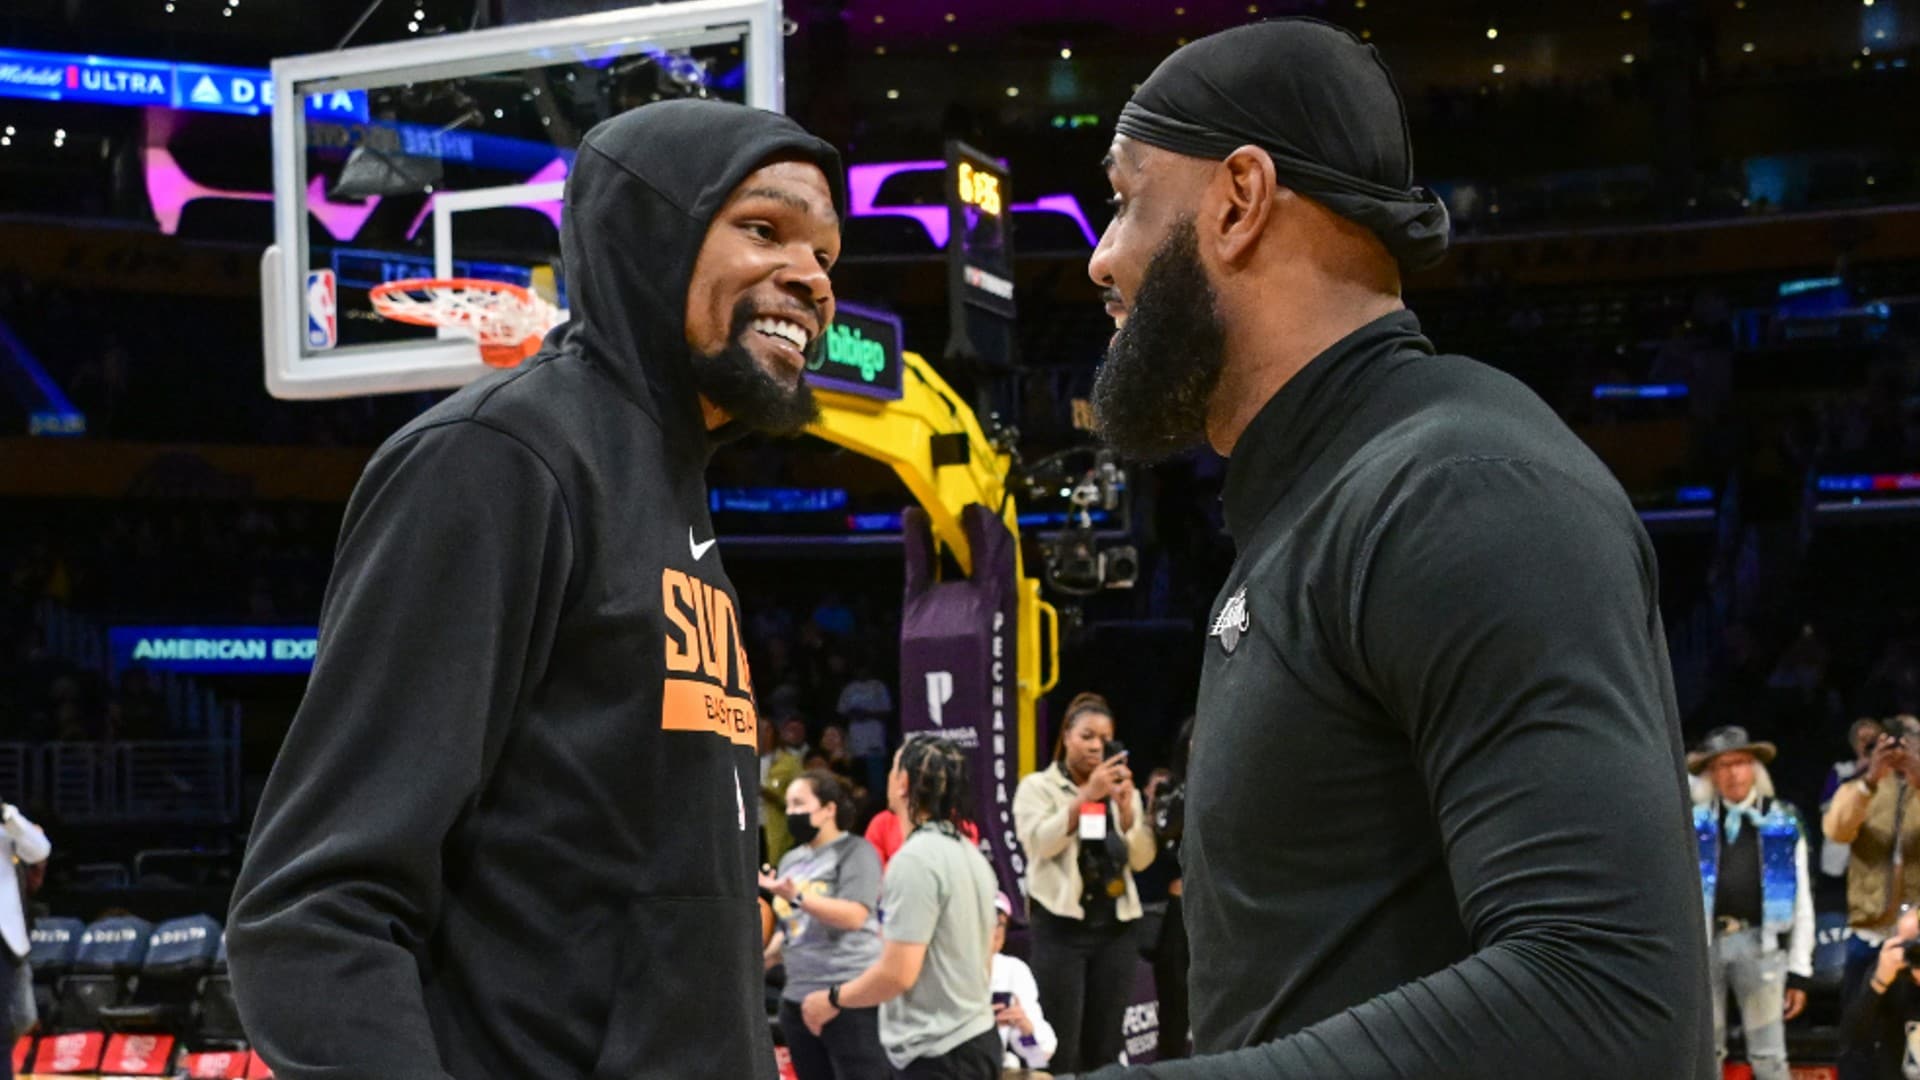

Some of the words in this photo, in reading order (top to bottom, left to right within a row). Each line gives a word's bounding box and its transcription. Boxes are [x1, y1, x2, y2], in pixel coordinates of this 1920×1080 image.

[81, 69, 166, 94] ULTRA
[827, 323, 885, 382] bibigo
[132, 637, 267, 660] AMERICAN
